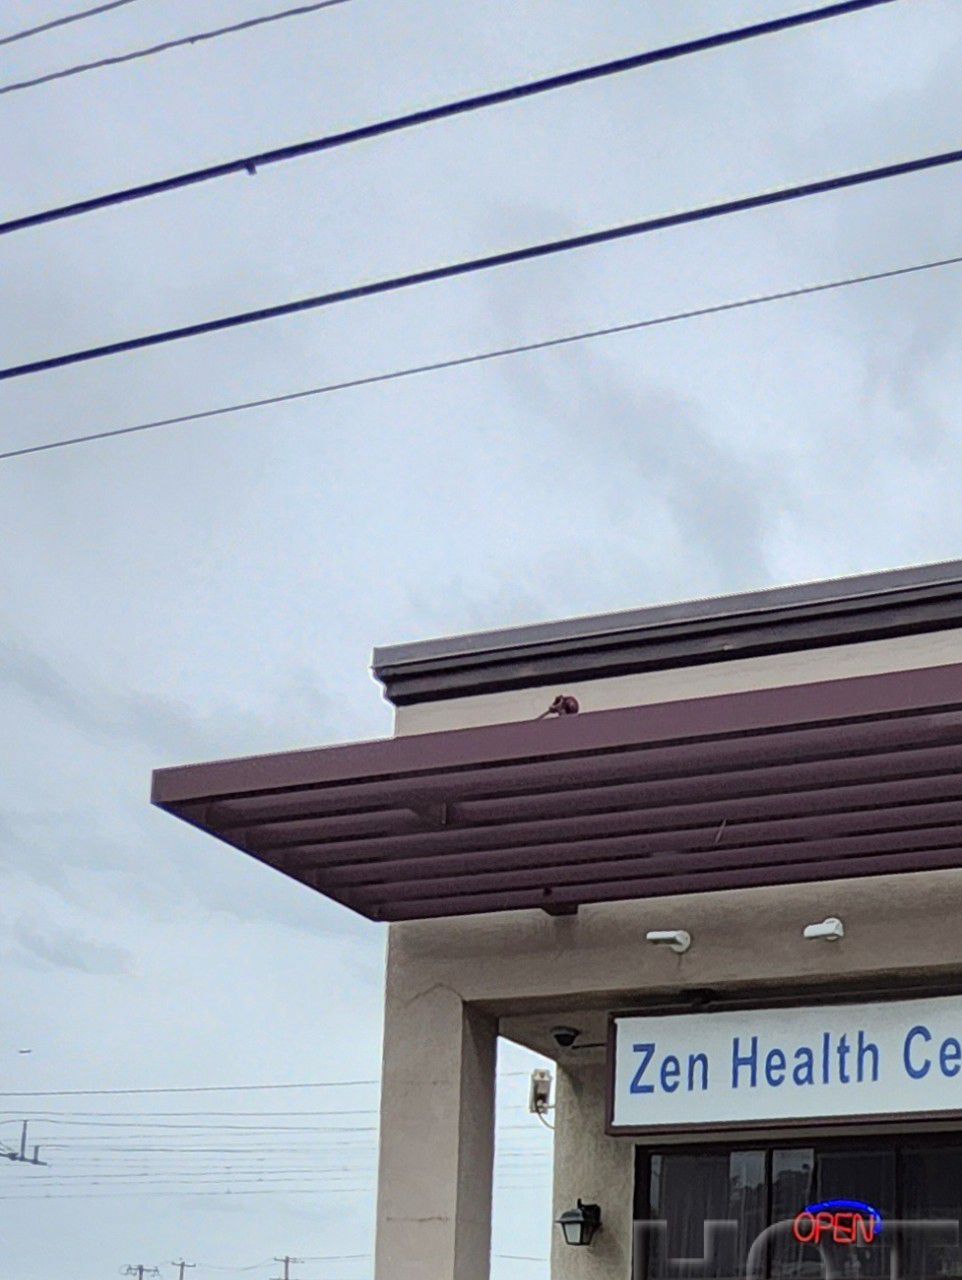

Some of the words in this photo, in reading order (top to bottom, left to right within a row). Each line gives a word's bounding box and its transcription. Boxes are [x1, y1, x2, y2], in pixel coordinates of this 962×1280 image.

[629, 1042, 709, 1095] Zen
[731, 1029, 880, 1089] Health
[793, 1212, 875, 1243] OPEN
